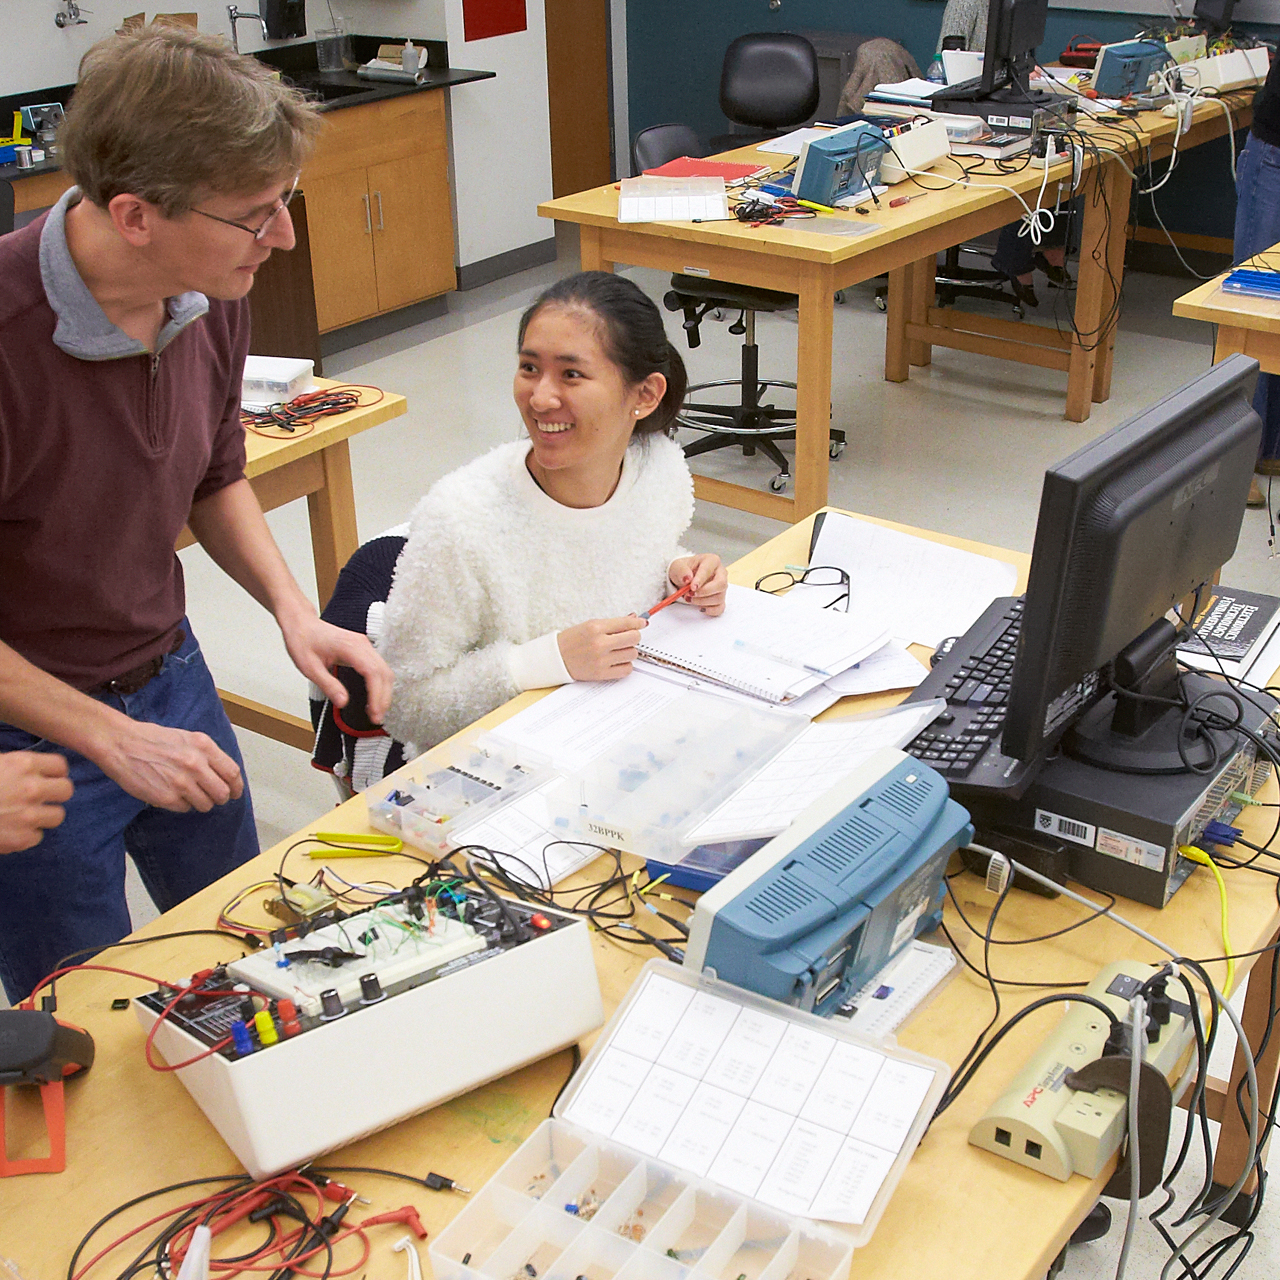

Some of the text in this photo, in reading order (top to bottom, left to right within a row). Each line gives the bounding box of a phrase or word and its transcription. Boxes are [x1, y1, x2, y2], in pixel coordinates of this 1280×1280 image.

[1211, 602, 1246, 639] TECHNOLOGY
[1224, 604, 1259, 640] ELECTRONICS
[588, 823, 625, 841] 32BPPK
[1022, 1086, 1044, 1108] APC
